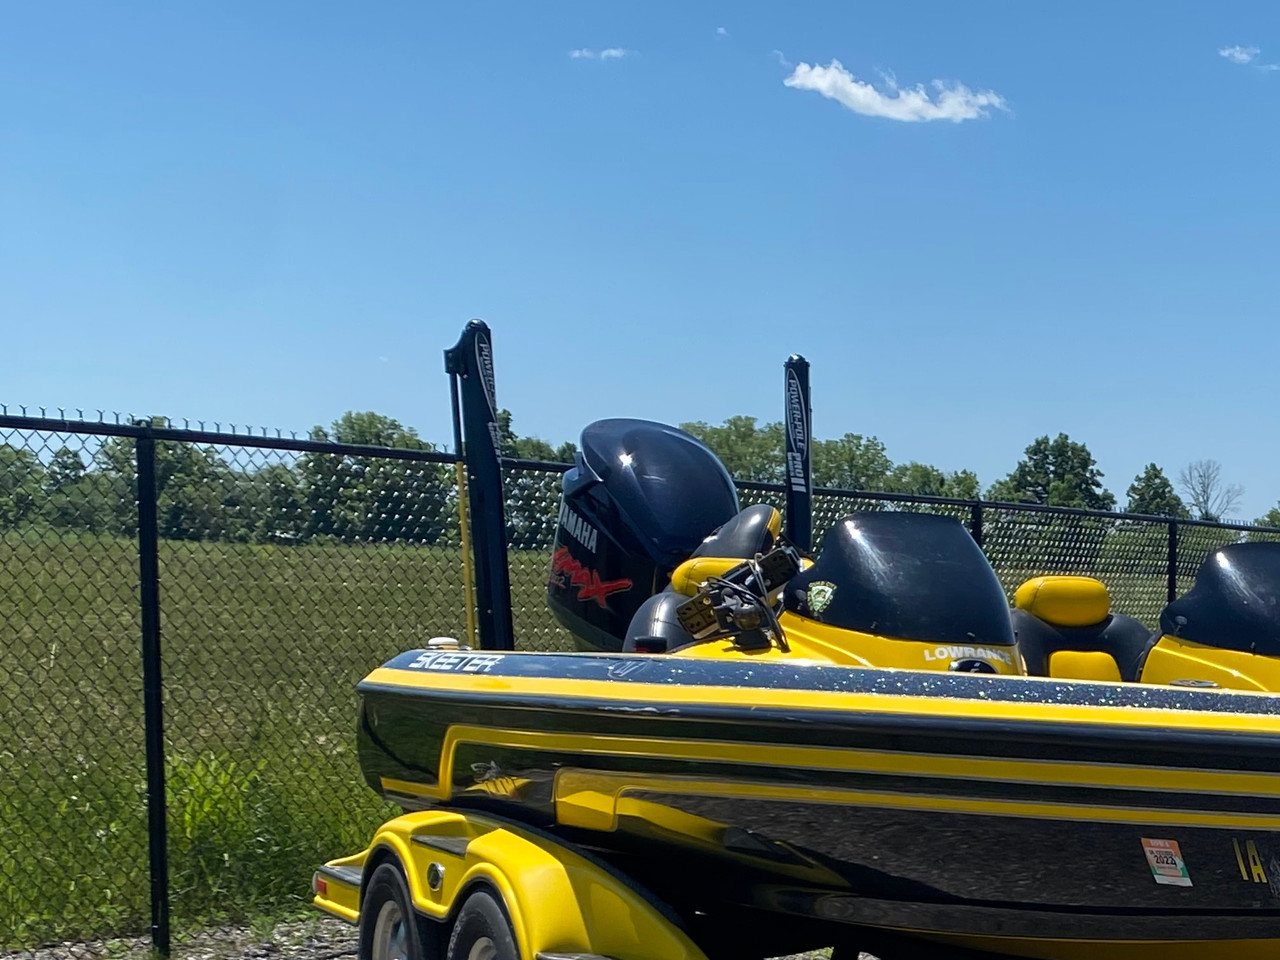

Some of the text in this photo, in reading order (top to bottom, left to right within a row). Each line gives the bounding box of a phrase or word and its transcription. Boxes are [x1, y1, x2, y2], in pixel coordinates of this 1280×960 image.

[789, 379, 806, 449] POWER-POLE
[793, 452, 804, 477] PRO
[408, 652, 505, 672] SKEETER
[1232, 837, 1268, 884] IA
